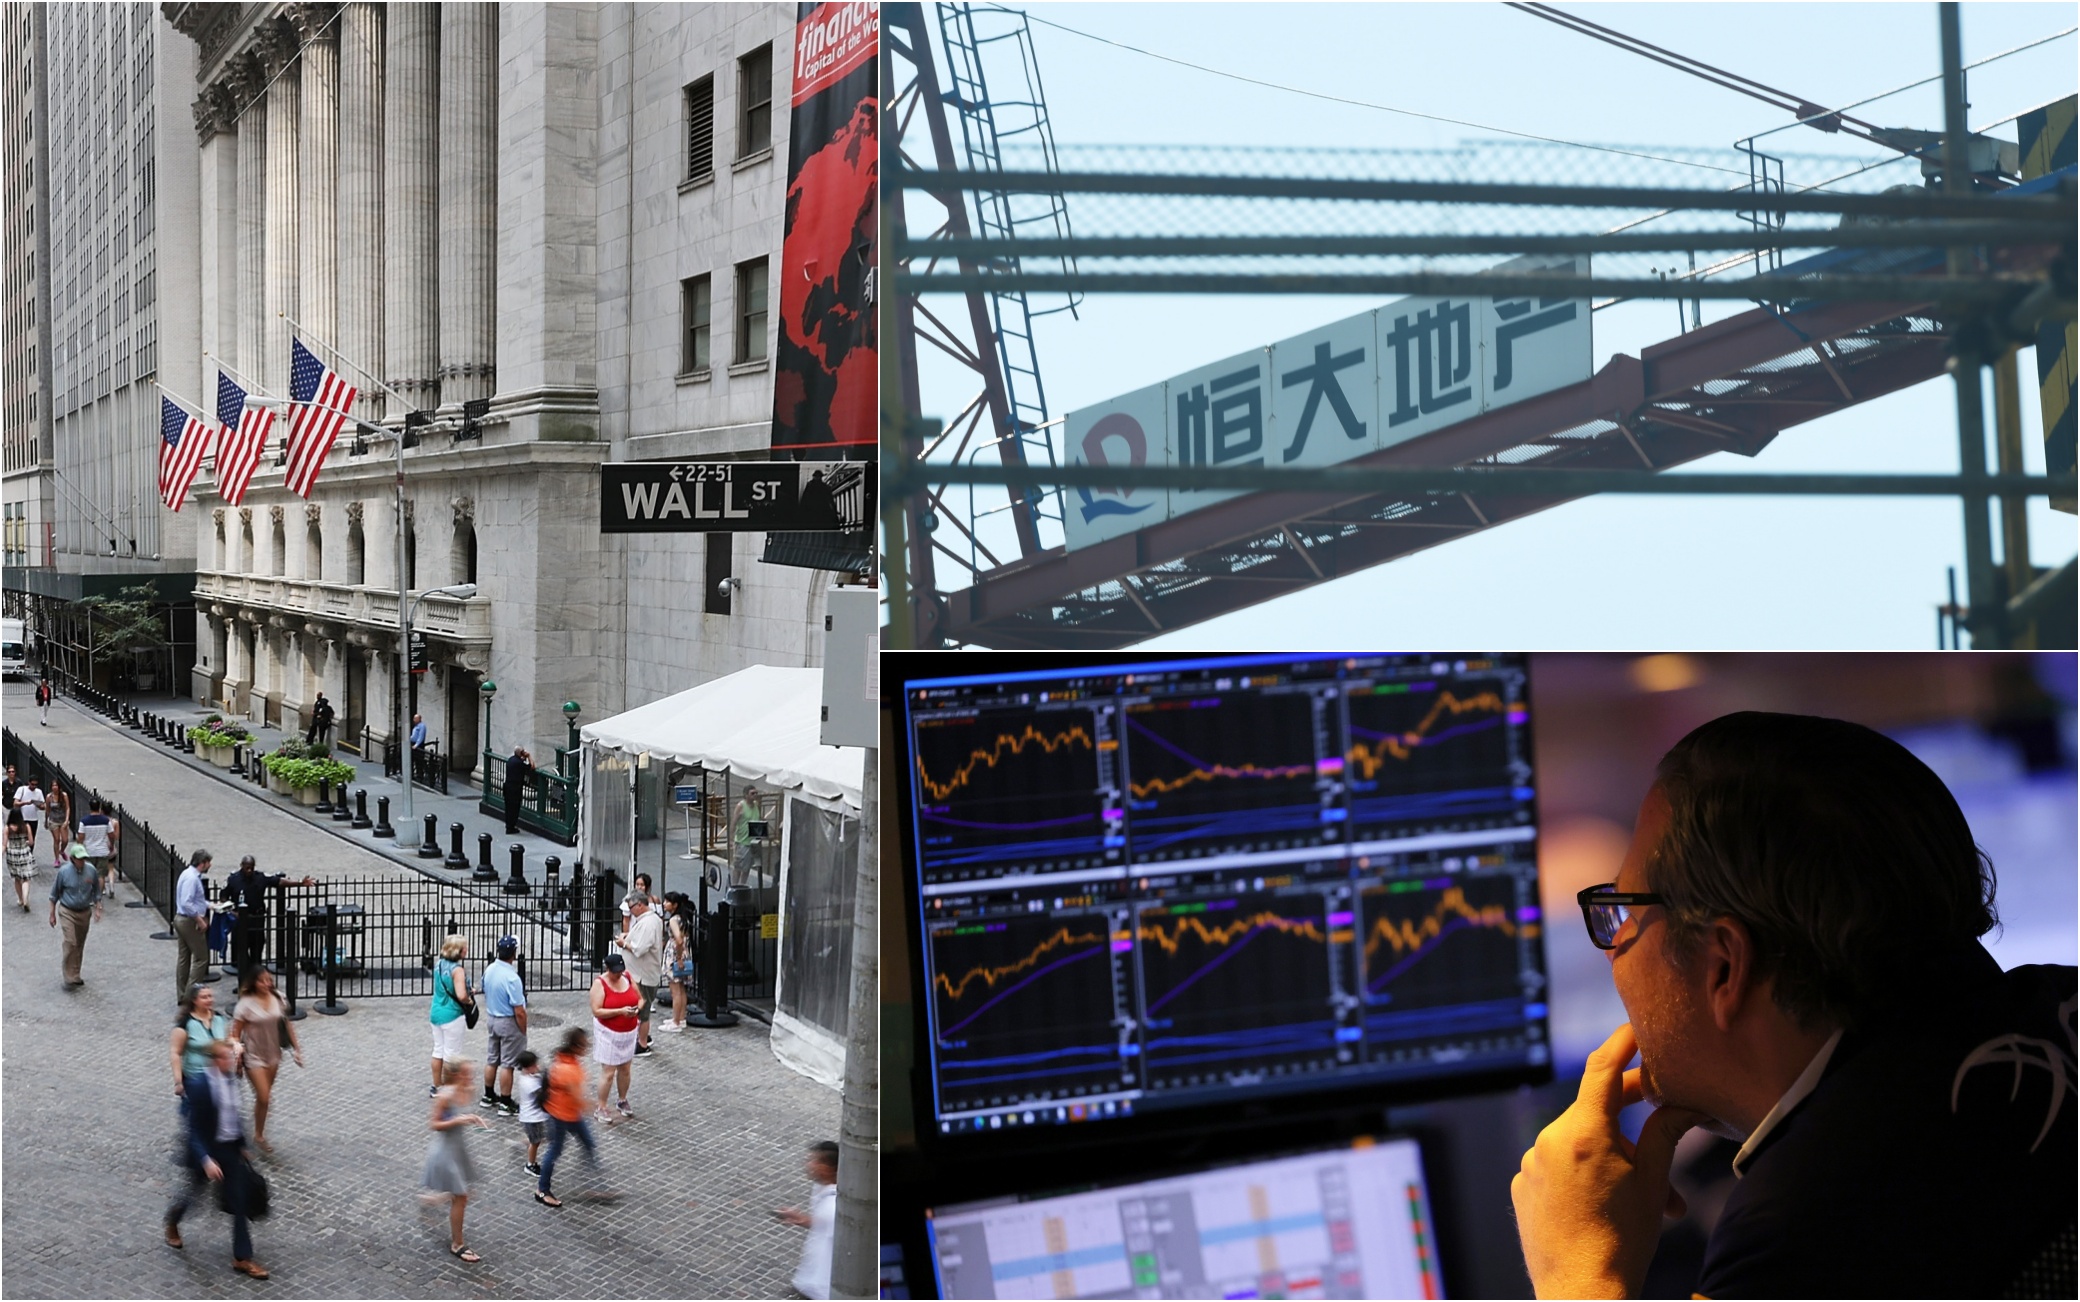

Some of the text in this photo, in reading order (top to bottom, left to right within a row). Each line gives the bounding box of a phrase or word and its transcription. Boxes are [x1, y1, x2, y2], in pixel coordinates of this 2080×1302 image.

[805, 47, 835, 79] Capital
[837, 39, 847, 59] of
[848, 31, 861, 51] the
[686, 464, 732, 482] 22-51
[621, 480, 781, 520] WALL ST
